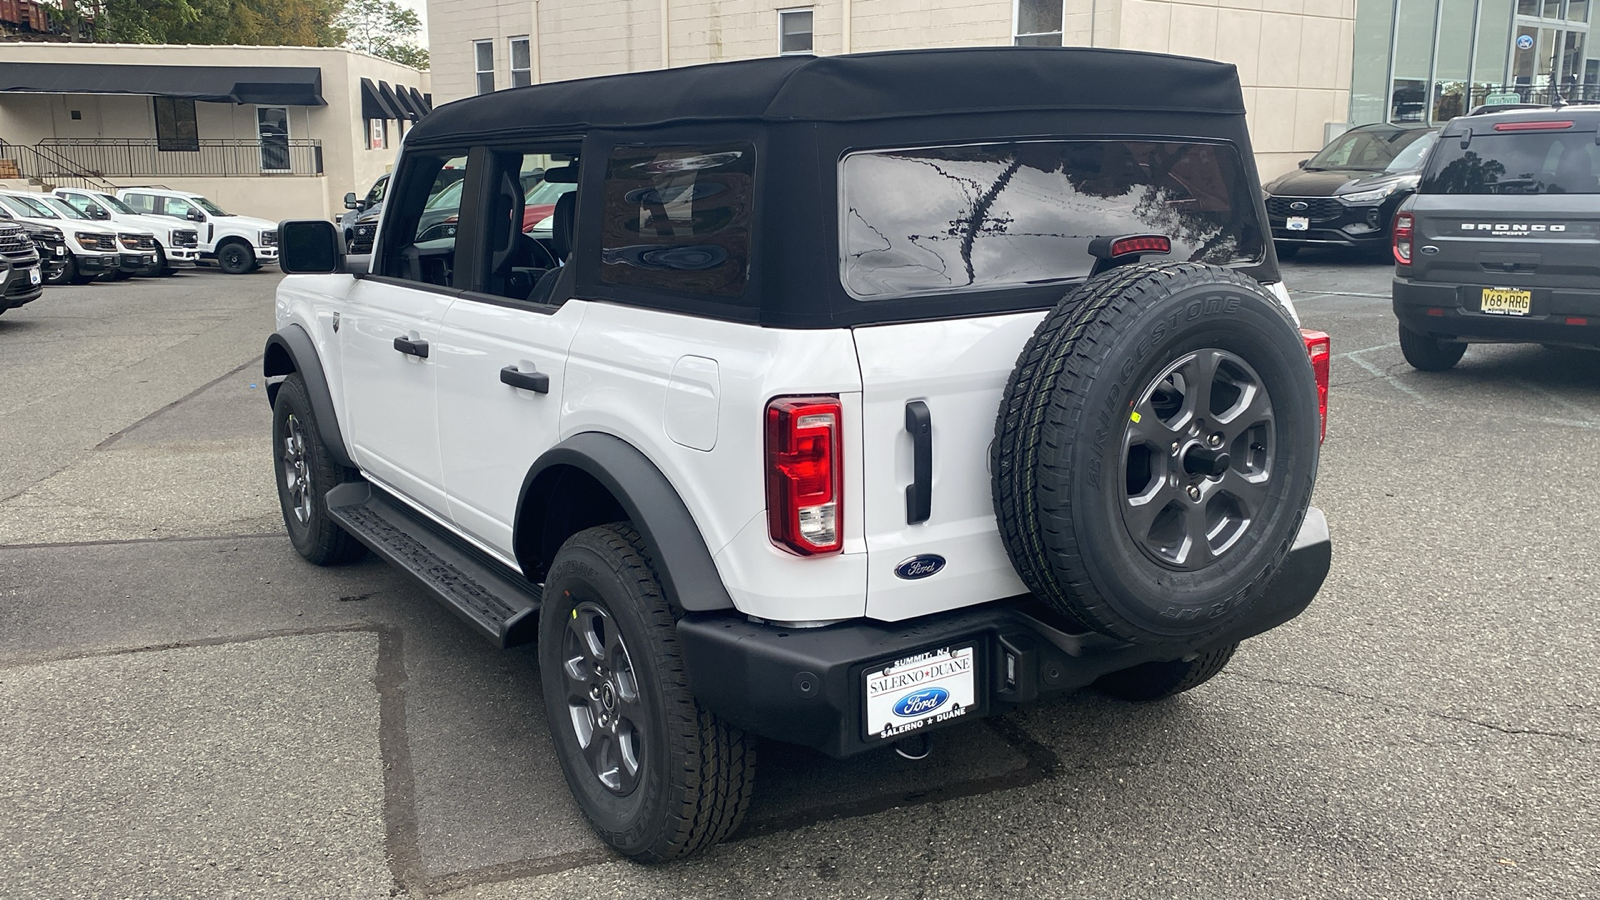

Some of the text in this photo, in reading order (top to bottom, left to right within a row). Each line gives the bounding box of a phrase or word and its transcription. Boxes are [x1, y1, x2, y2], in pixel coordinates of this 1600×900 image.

[1461, 223, 1566, 232] BRONCO
[1484, 293, 1529, 309] V68 RRG
[1086, 295, 1241, 492] BRIDGESTONE
[937, 646, 950, 657] NJ
[870, 657, 971, 695] SALERNO DUANE
[904, 691, 939, 714] Ford
[880, 707, 966, 739] SALERNO DUANE
